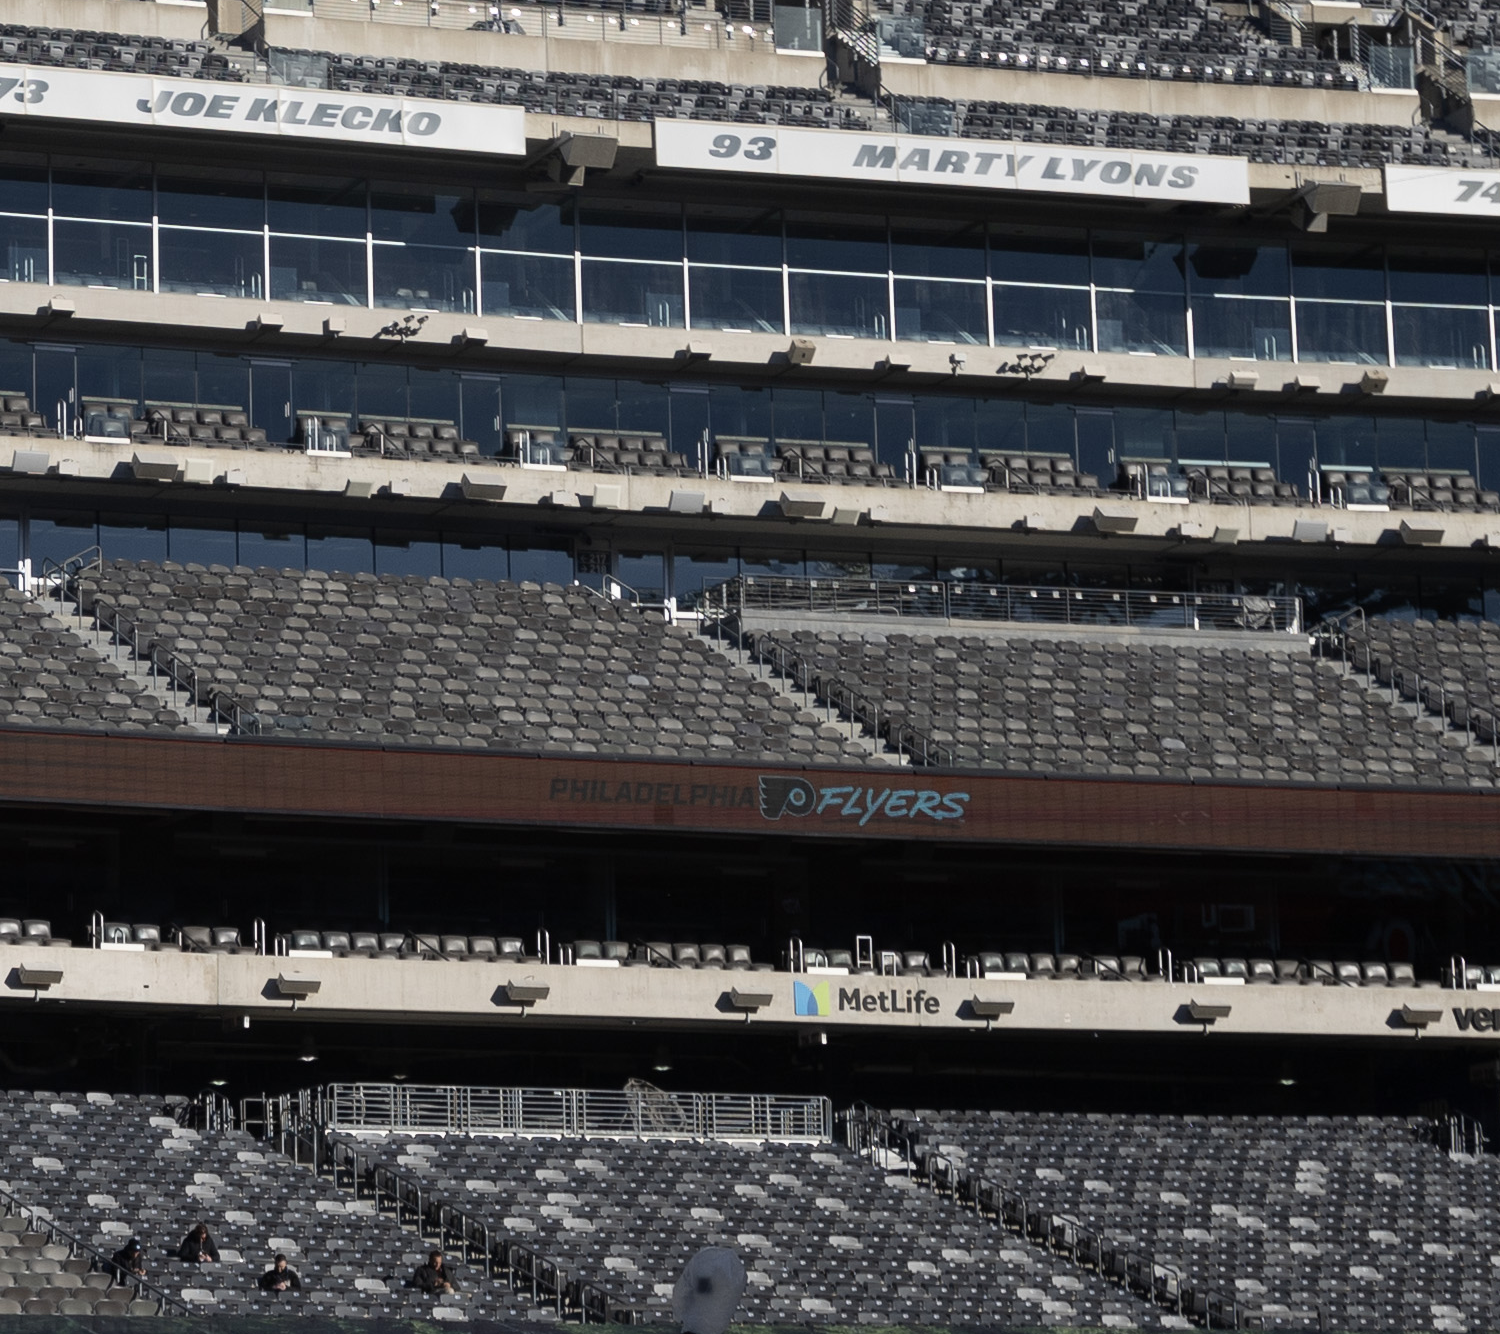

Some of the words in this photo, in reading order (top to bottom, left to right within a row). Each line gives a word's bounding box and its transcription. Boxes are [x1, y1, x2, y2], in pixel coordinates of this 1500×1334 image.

[136, 90, 239, 120] JOE
[244, 98, 442, 137] KLECKO
[707, 134, 777, 161] 93
[852, 143, 1035, 177] MARTY
[1040, 156, 1200, 189] LYONS
[589, 553, 607, 563] 217
[550, 778, 755, 809] PHILADELPHIA
[815, 786, 970, 827] FLYERS
[837, 986, 942, 1016] MetLife
